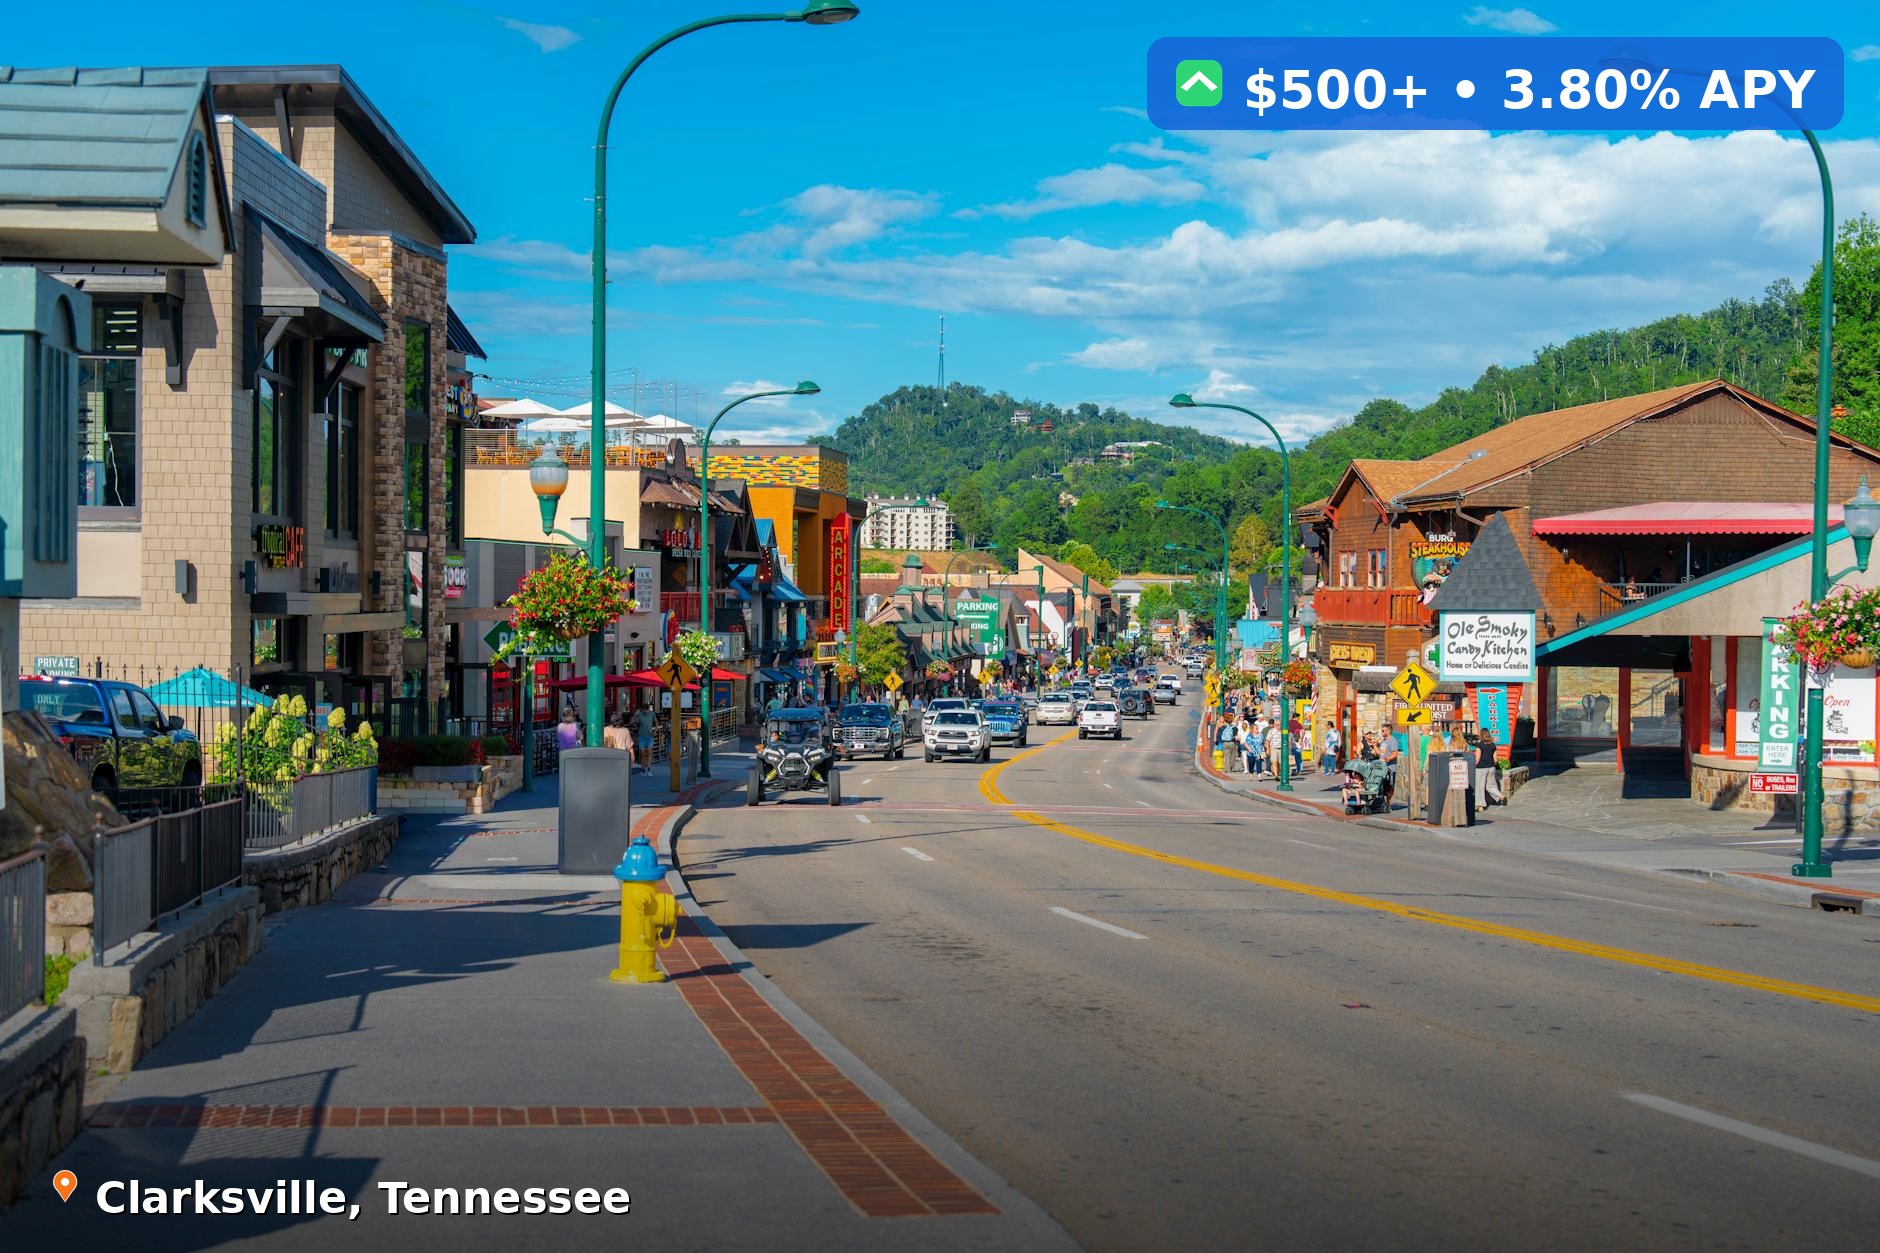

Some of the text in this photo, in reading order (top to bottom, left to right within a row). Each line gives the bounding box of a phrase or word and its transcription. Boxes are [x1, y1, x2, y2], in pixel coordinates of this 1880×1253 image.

[1429, 534, 1454, 542] BURG
[285, 526, 304, 569] CAFE
[833, 530, 844, 627] ARCADE
[957, 602, 999, 611] PARKING
[1447, 615, 1527, 644] Ole Smoky
[1447, 639, 1527, 662] Candy Kitchen
[37, 657, 75, 668] PRIVATE
[37, 694, 60, 704] ONLY
[1824, 695, 1851, 708] Open
[1752, 779, 1764, 788] NO
